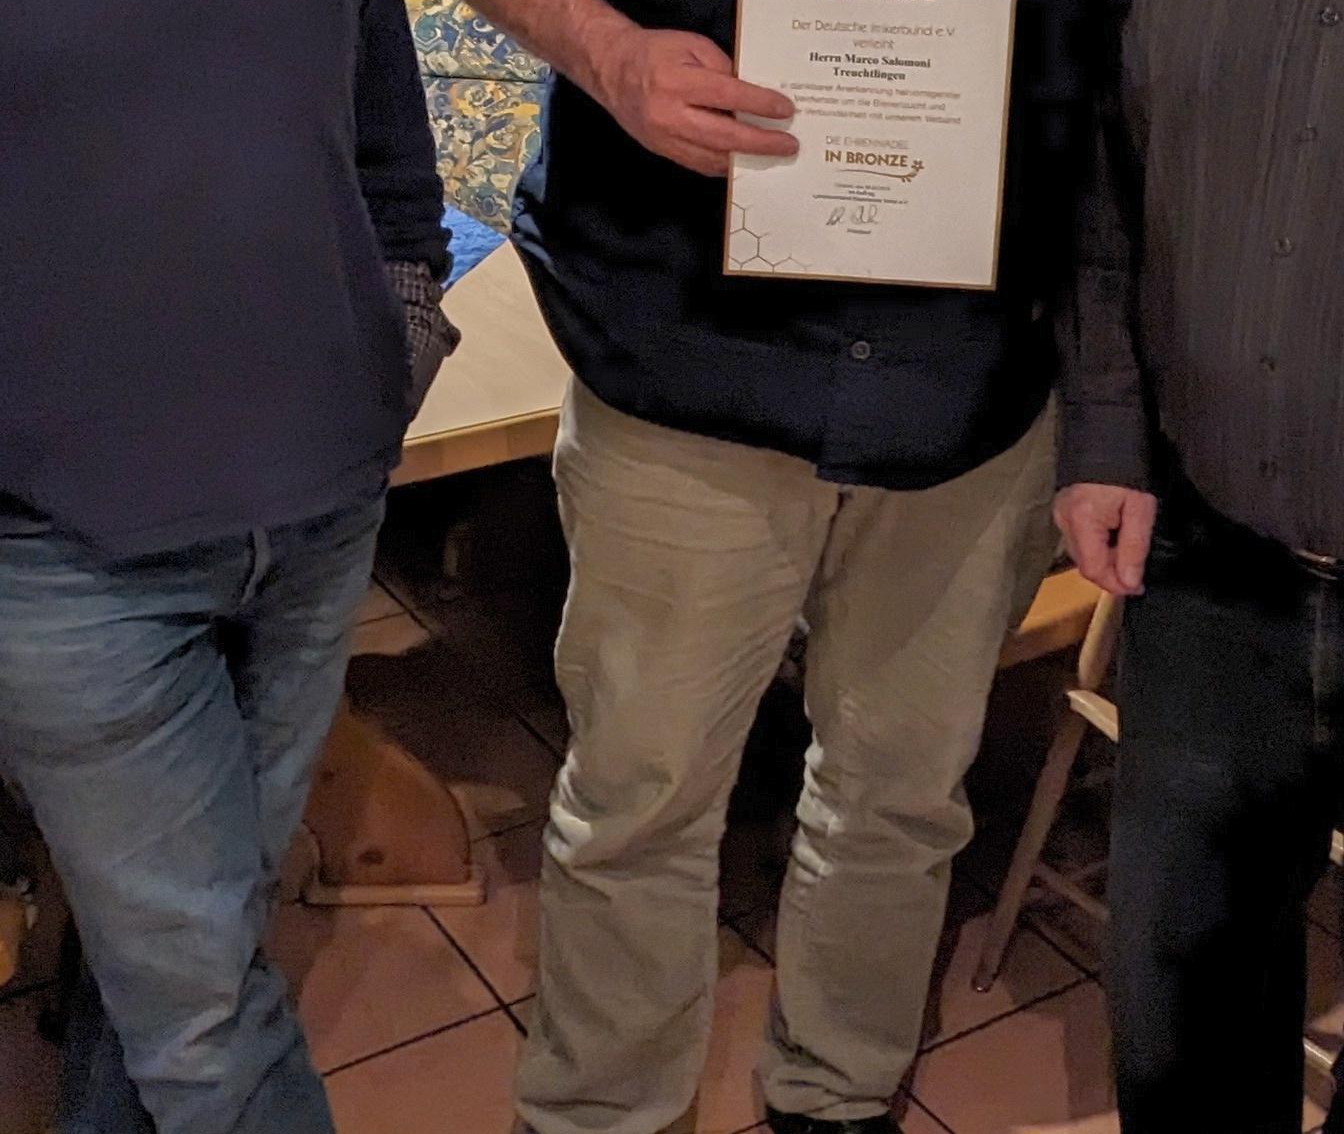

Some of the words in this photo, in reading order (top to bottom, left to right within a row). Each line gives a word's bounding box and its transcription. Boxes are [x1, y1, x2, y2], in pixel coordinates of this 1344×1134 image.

[792, 19, 811, 31] Der
[815, 19, 867, 34] Deutsche
[809, 51, 842, 63] Herrn
[844, 53, 880, 66] Marco
[833, 67, 907, 81] Treuchtlingen
[825, 149, 842, 163] IN
[846, 151, 909, 168] BRONZE
